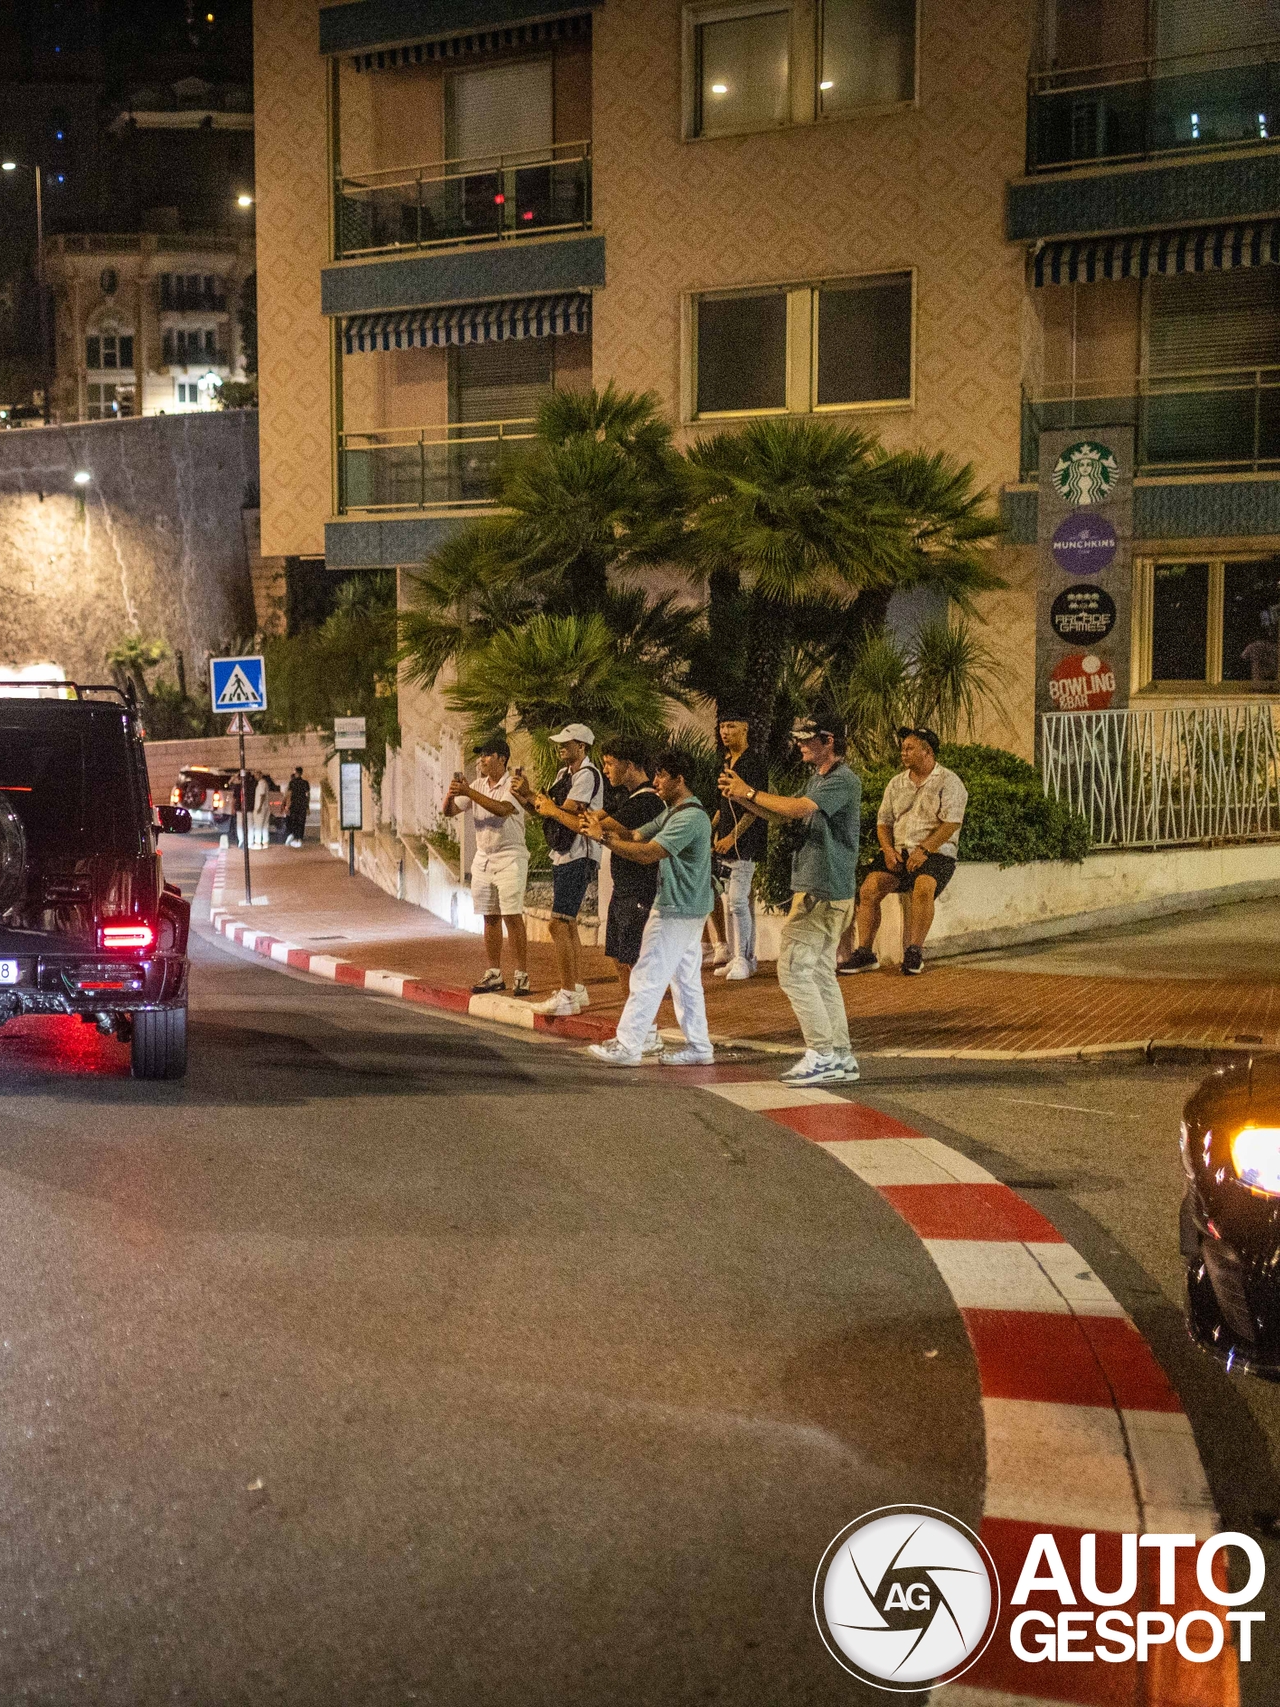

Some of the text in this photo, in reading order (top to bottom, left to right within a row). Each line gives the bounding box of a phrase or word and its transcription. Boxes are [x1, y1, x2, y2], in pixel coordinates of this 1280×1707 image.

[1053, 539, 1115, 550] MUNCHKINS
[1055, 613, 1111, 624] ARCADE
[1060, 622, 1106, 632] GAMES
[1049, 671, 1116, 700] BOWLING
